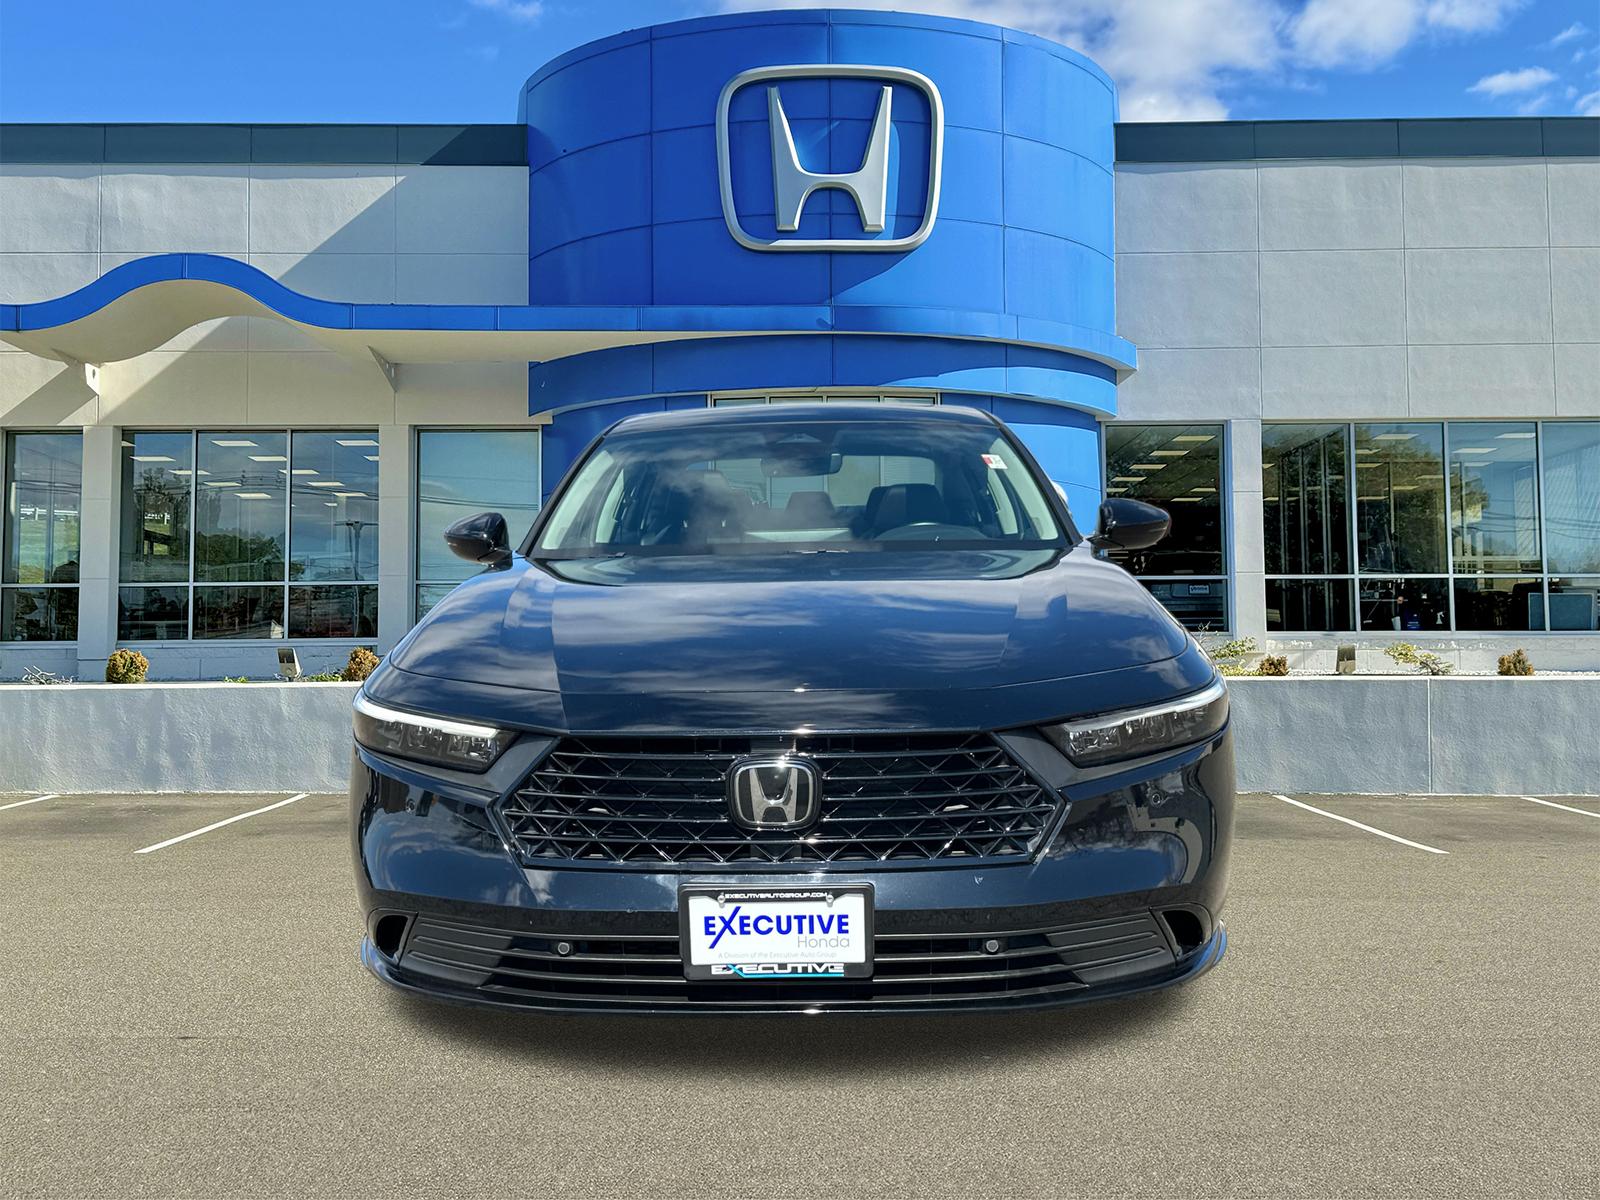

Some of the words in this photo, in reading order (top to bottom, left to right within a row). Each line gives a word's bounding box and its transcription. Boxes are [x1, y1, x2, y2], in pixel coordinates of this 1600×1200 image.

[704, 906, 849, 949] EXECUTIVE
[797, 935, 850, 948] Honda
[758, 951, 768, 959] the
[769, 951, 799, 959] Executive
[816, 951, 837, 959] Group
[711, 963, 845, 976] EXECUTIVE
